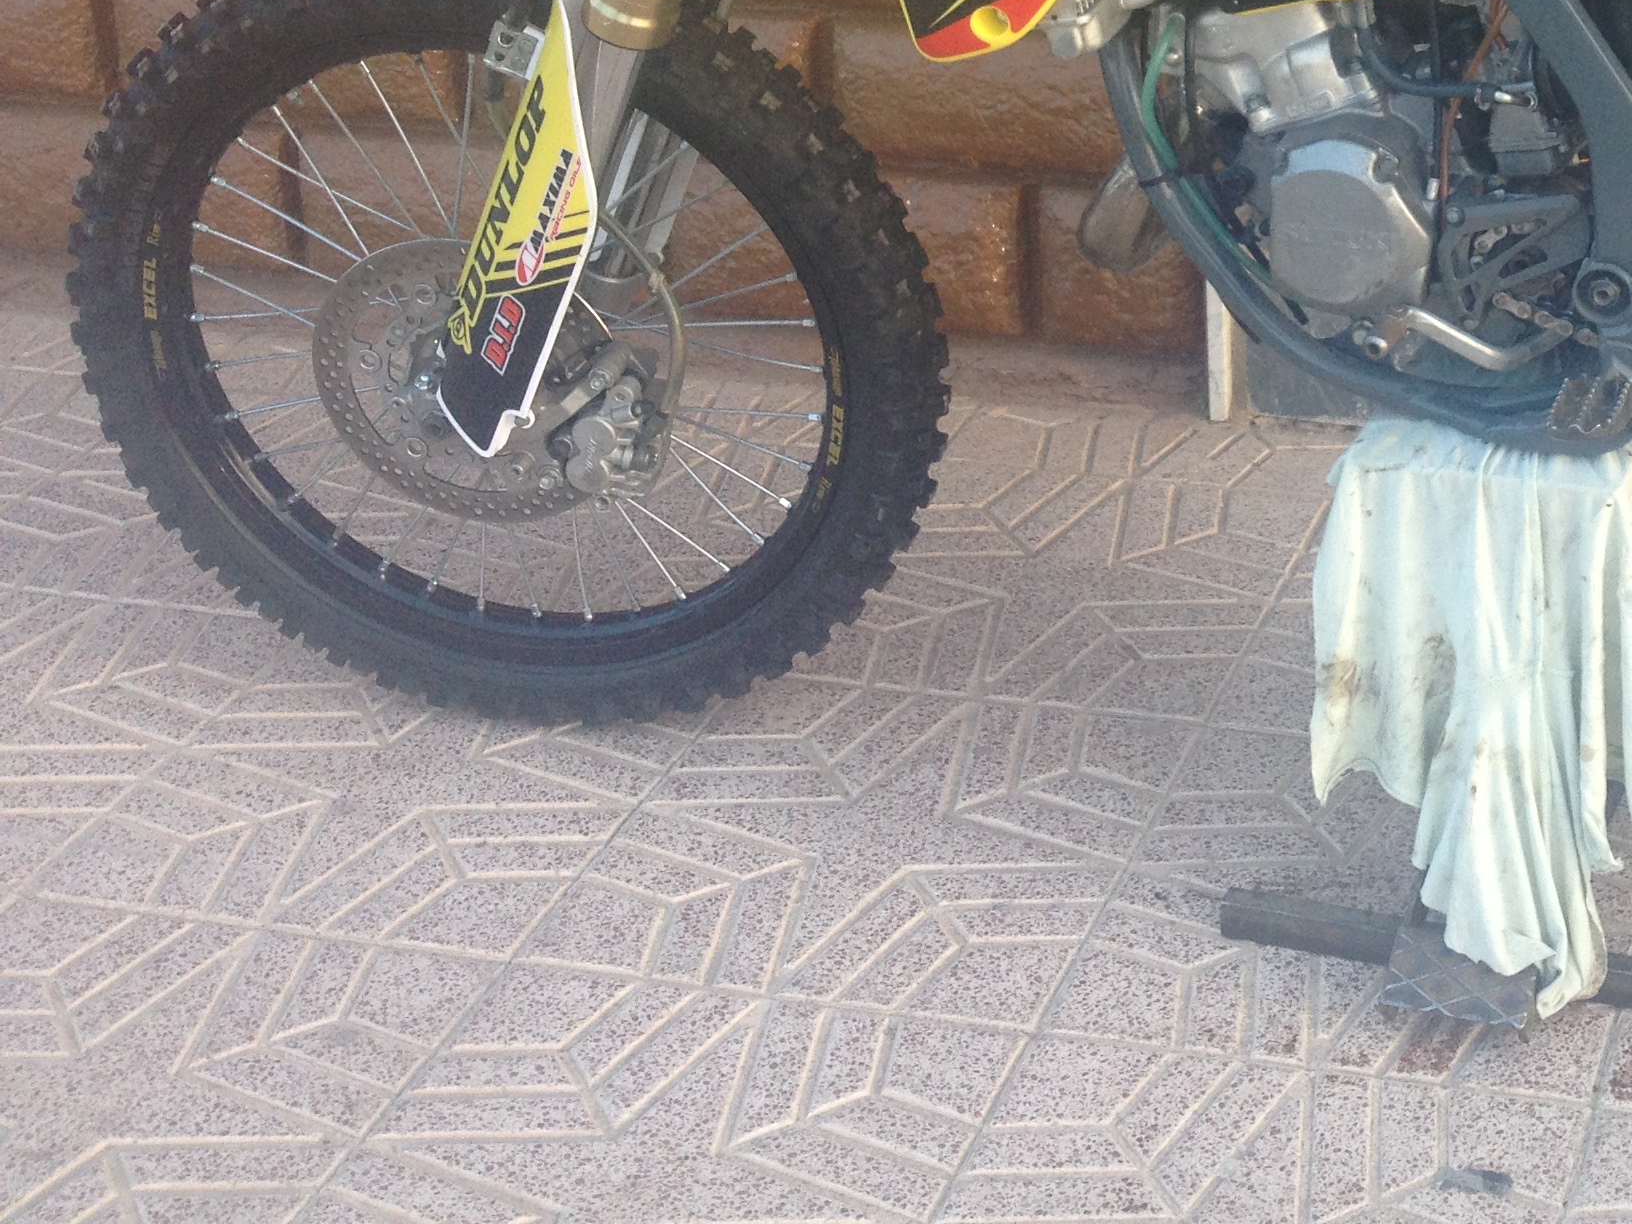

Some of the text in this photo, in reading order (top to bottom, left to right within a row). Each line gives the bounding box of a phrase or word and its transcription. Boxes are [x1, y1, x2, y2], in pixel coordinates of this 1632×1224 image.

[460, 75, 547, 322] DUNLOP
[529, 147, 574, 255] MAXIMA
[142, 258, 158, 320] EXCEL
[483, 296, 525, 374] D.I.D
[825, 403, 846, 467] EXCEL
